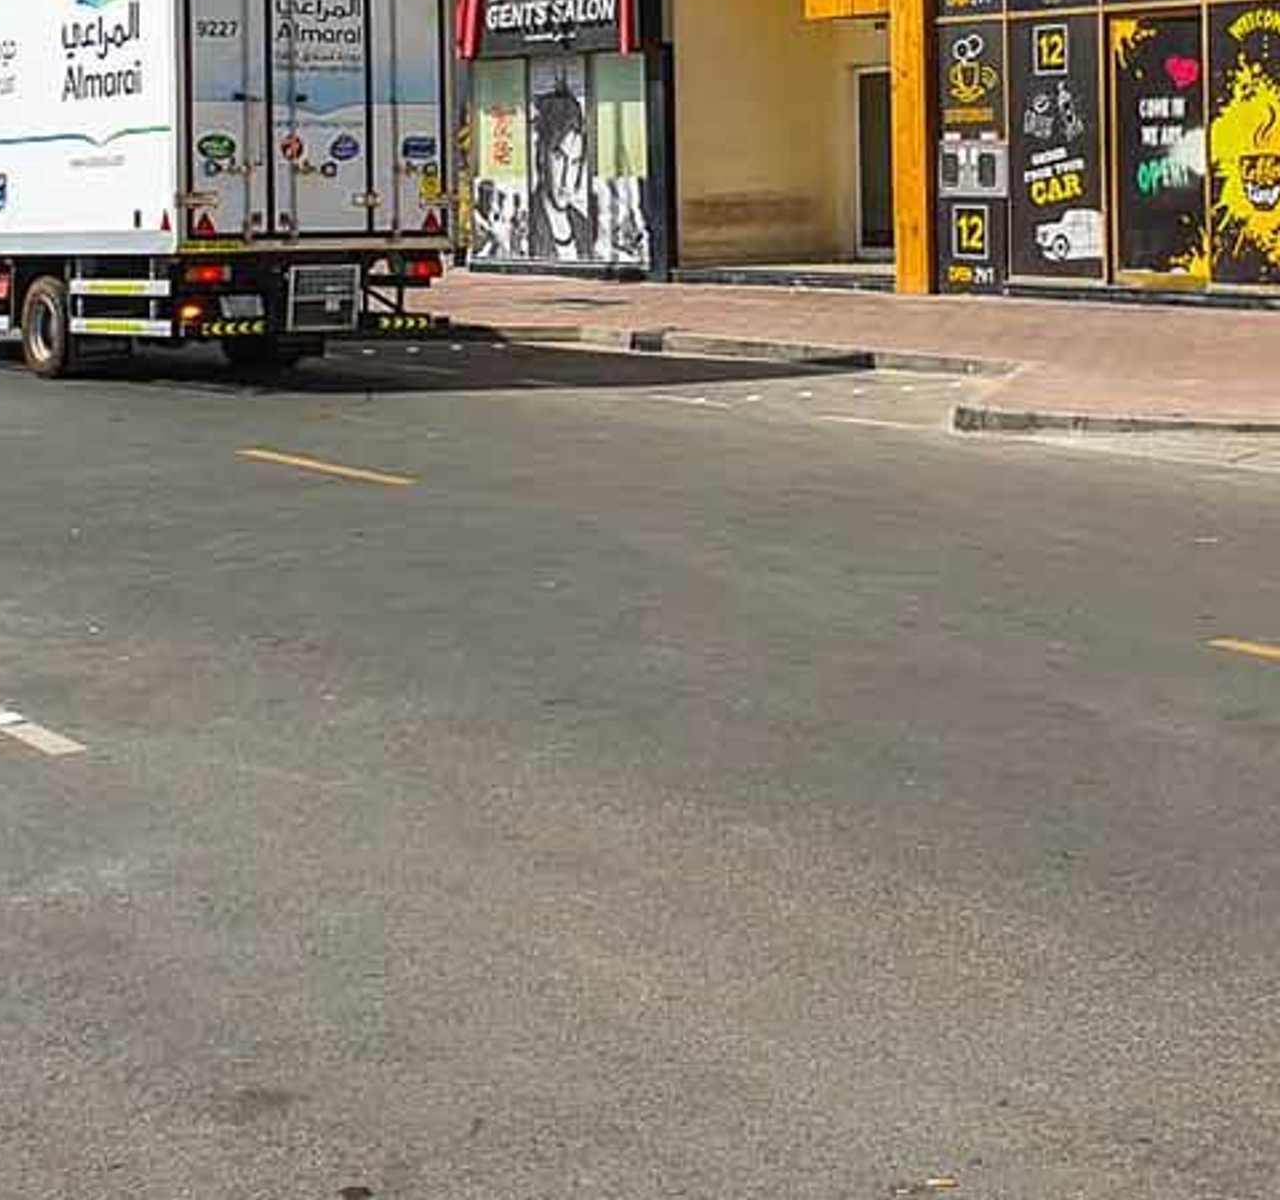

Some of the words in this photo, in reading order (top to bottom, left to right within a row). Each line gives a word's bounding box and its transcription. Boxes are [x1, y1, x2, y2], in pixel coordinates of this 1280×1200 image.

[62, 0, 139, 59] المراعي
[196, 19, 239, 37] 9227
[486, 1, 549, 30] GENTS
[1037, 33, 1065, 72] 12
[62, 59, 142, 102] Almarai
[1031, 174, 1083, 205] CAR
[956, 215, 983, 250] 12
